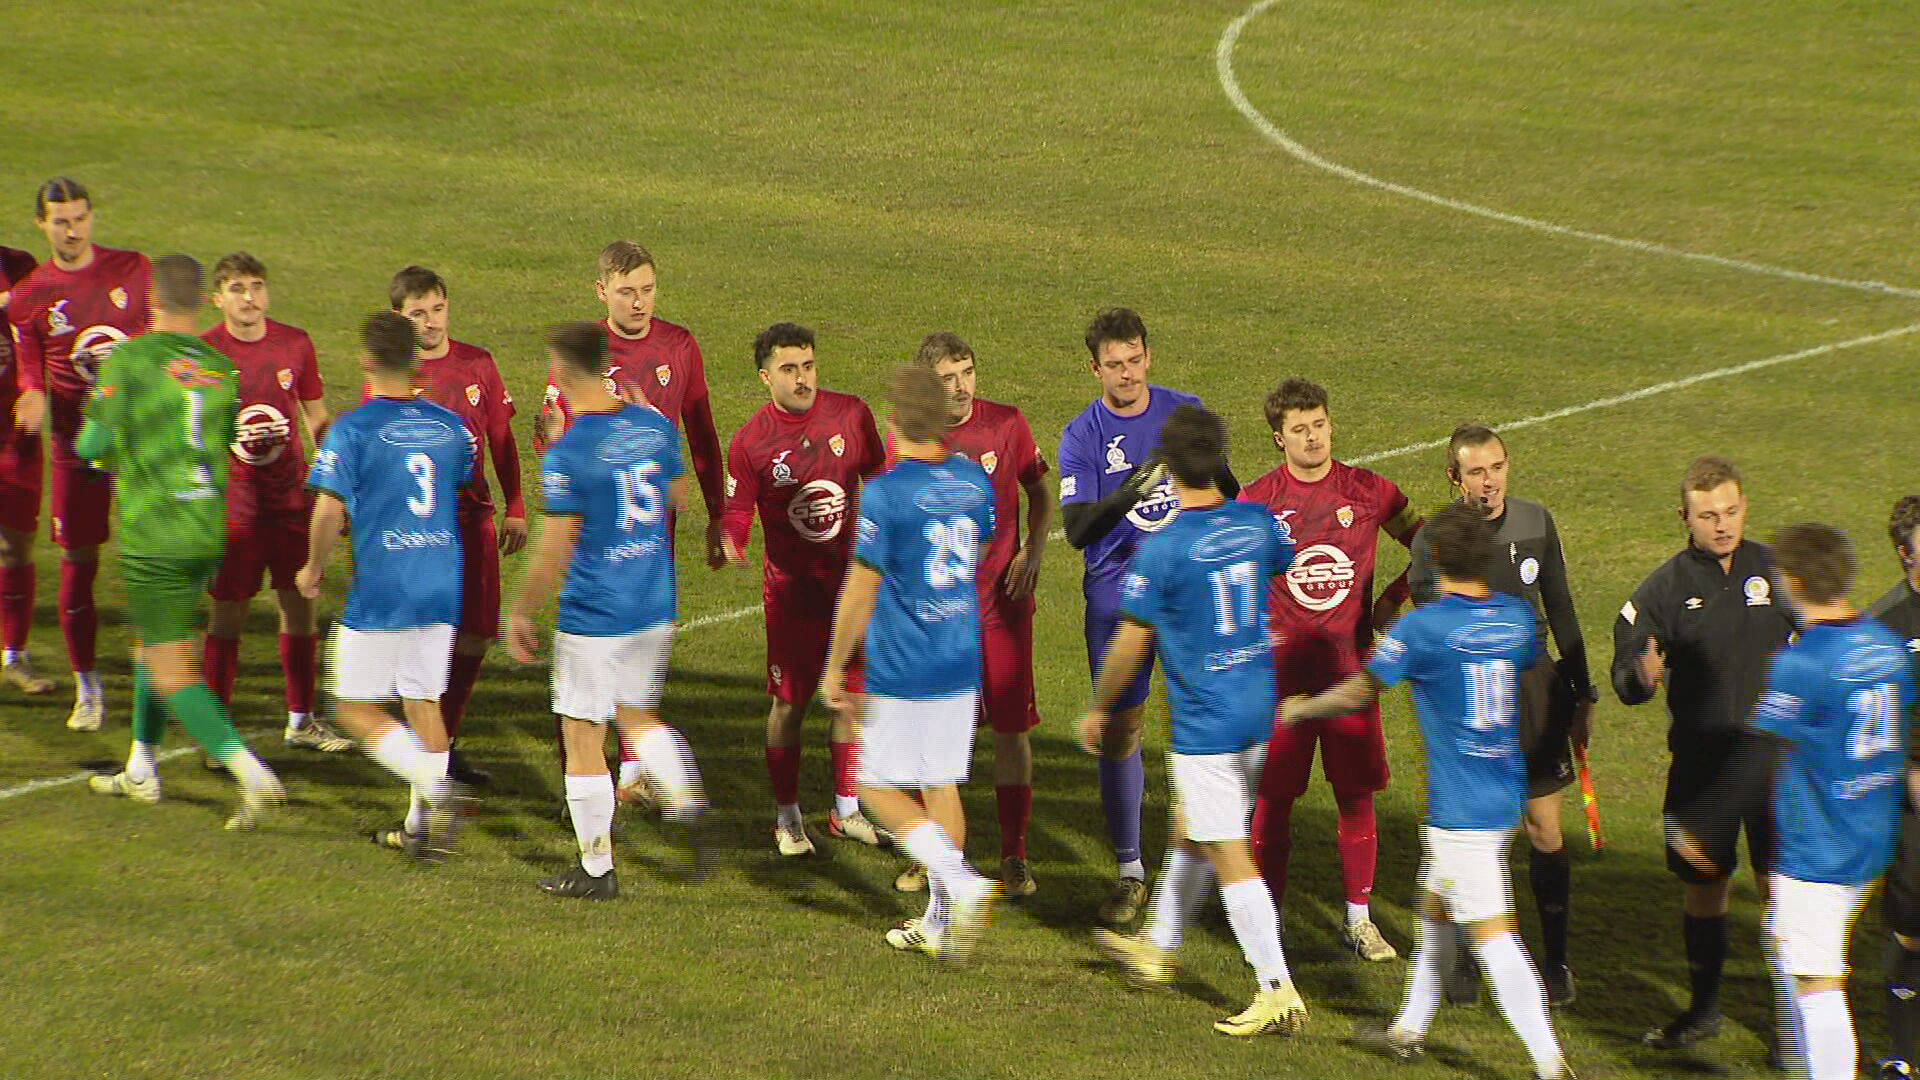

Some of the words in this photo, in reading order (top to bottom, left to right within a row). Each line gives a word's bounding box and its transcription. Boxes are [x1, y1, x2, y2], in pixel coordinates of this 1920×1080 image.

[405, 452, 436, 518] 3
[613, 459, 663, 533] 15
[922, 513, 980, 590] 29
[1286, 561, 1355, 584] GSS
[1306, 580, 1355, 591] GROUP
[1207, 561, 1258, 637] 17
